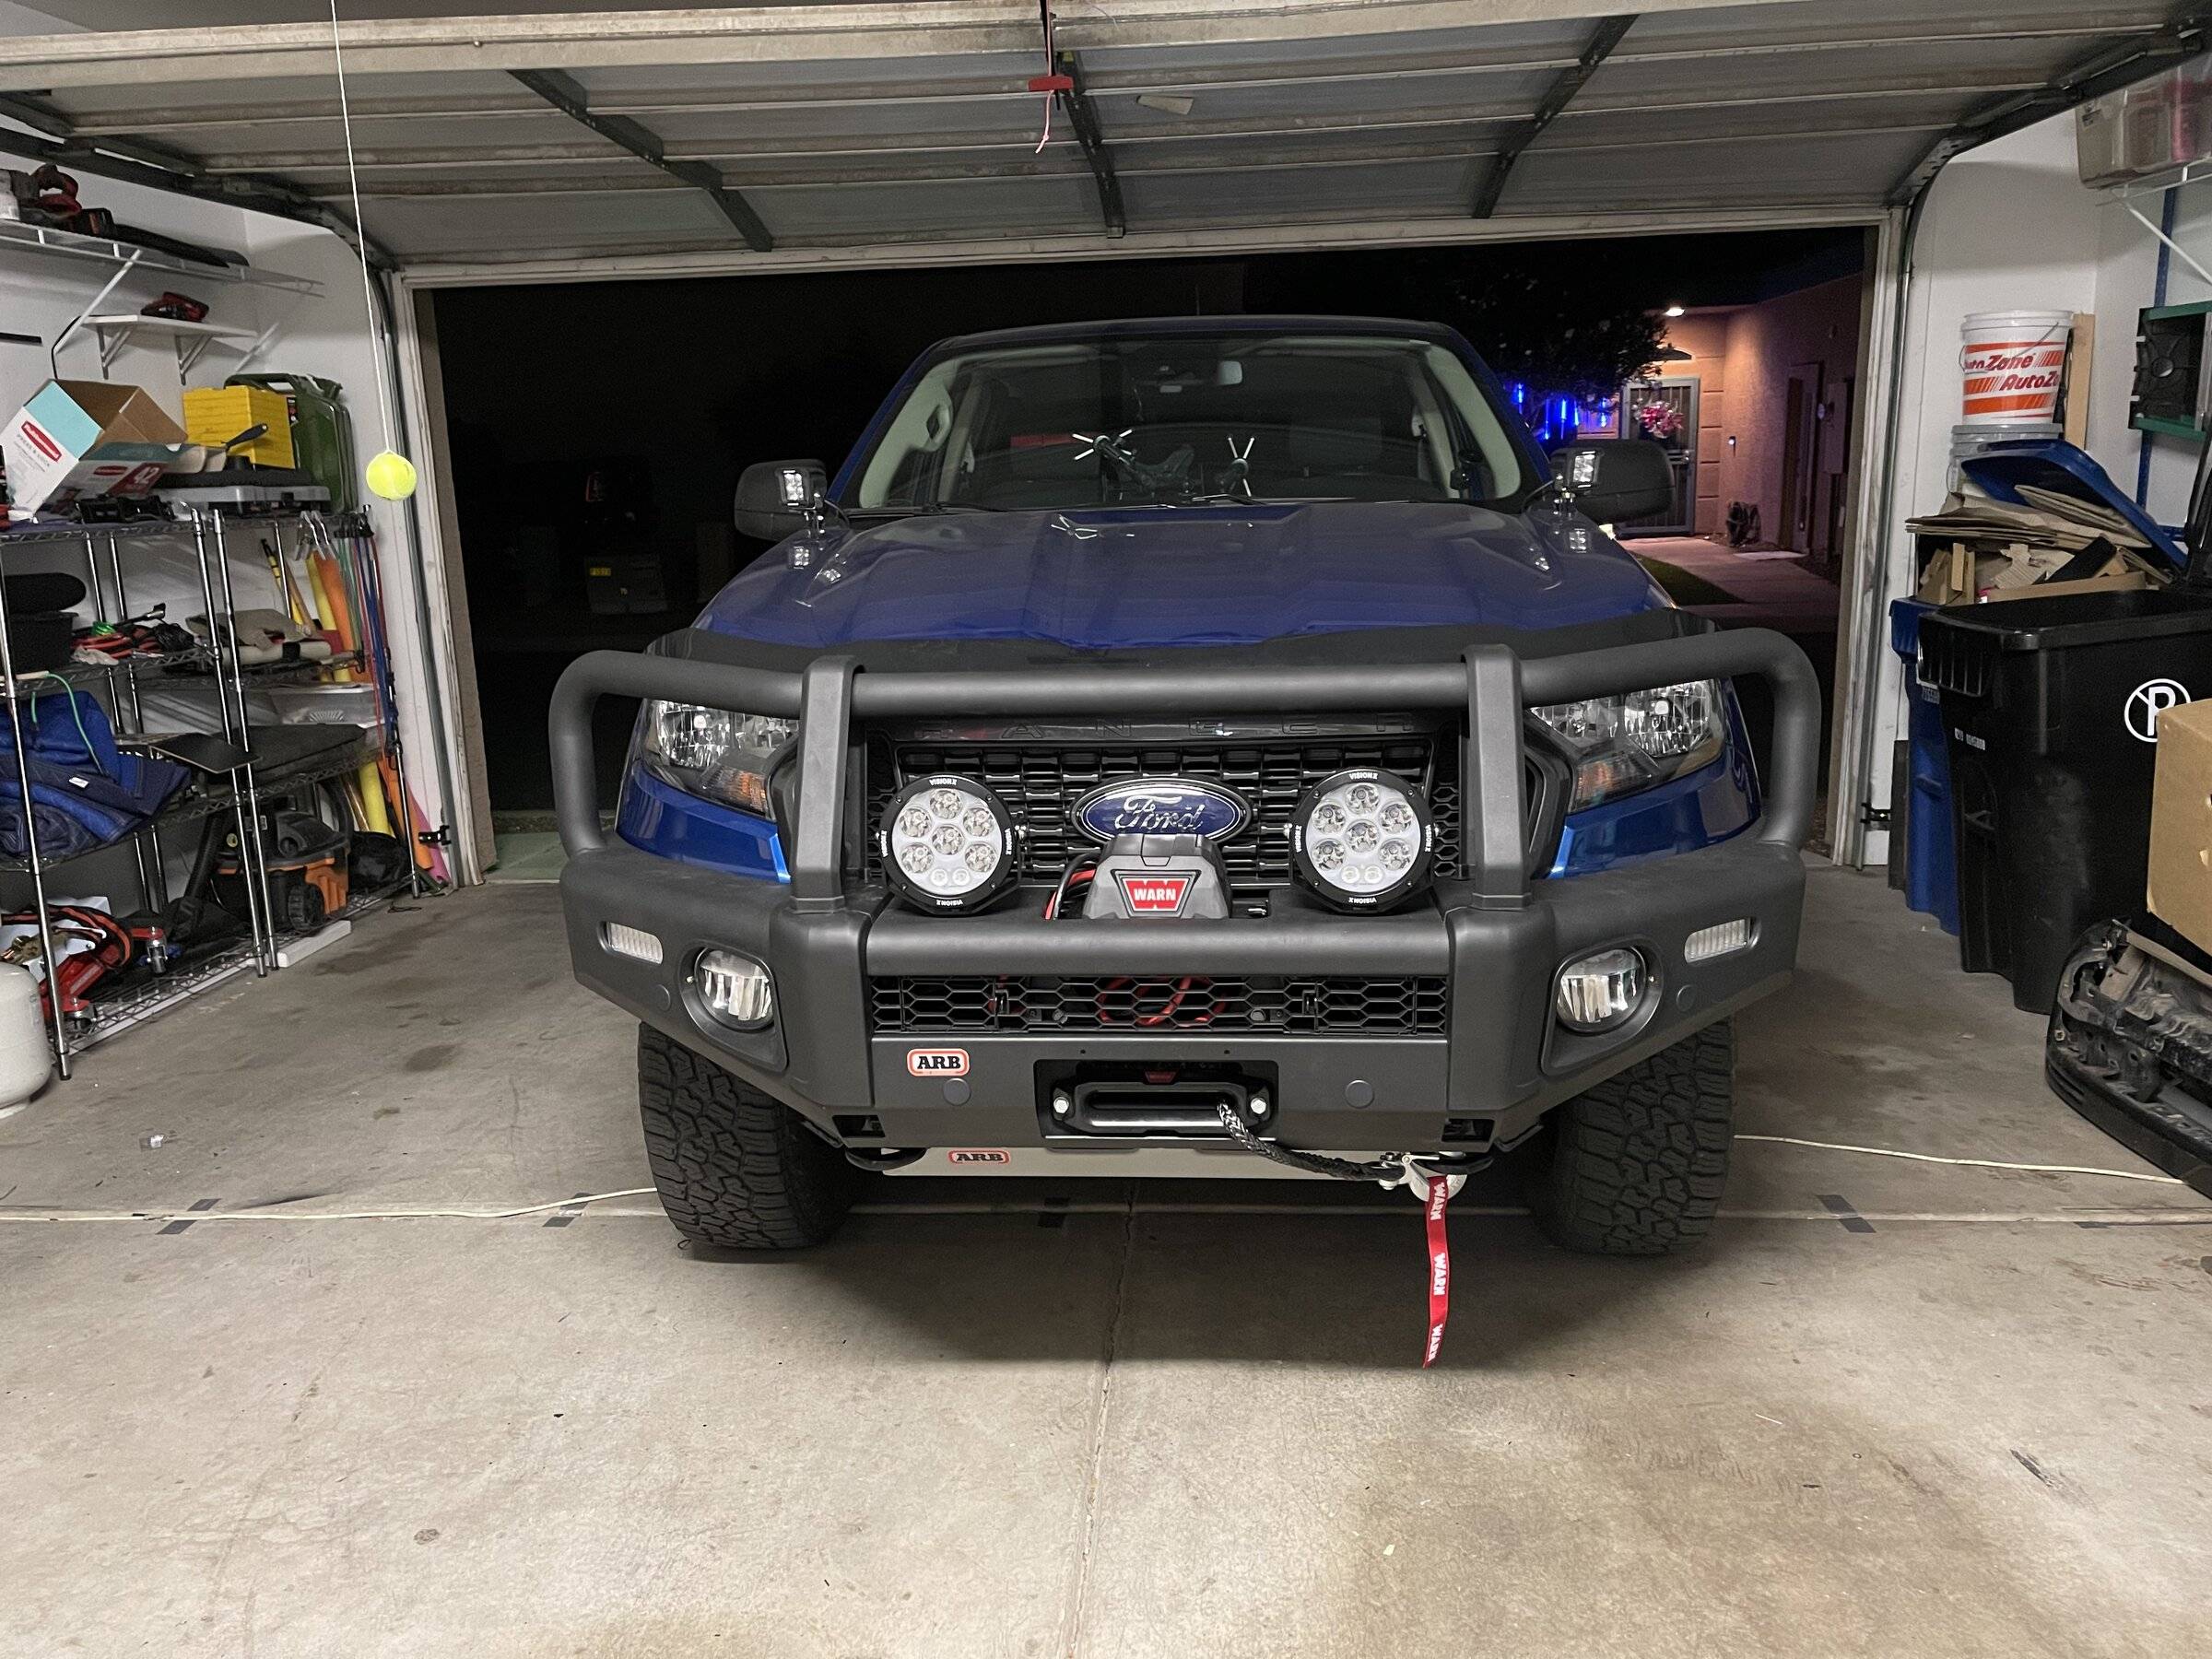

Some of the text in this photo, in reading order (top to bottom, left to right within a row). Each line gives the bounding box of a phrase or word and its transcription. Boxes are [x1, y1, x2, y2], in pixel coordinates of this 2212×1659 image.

[1964, 354, 2034, 371] utoZone
[134, 466, 159, 484] 42
[1114, 794, 1206, 830] Ford
[1134, 888, 1176, 901] WARN
[917, 1055, 961, 1069] ARB
[956, 1153, 1004, 1161] ARB
[1430, 1182, 1445, 1220] WARN
[1434, 1253, 1446, 1296] WARN
[1428, 1323, 1443, 1362] WARN
